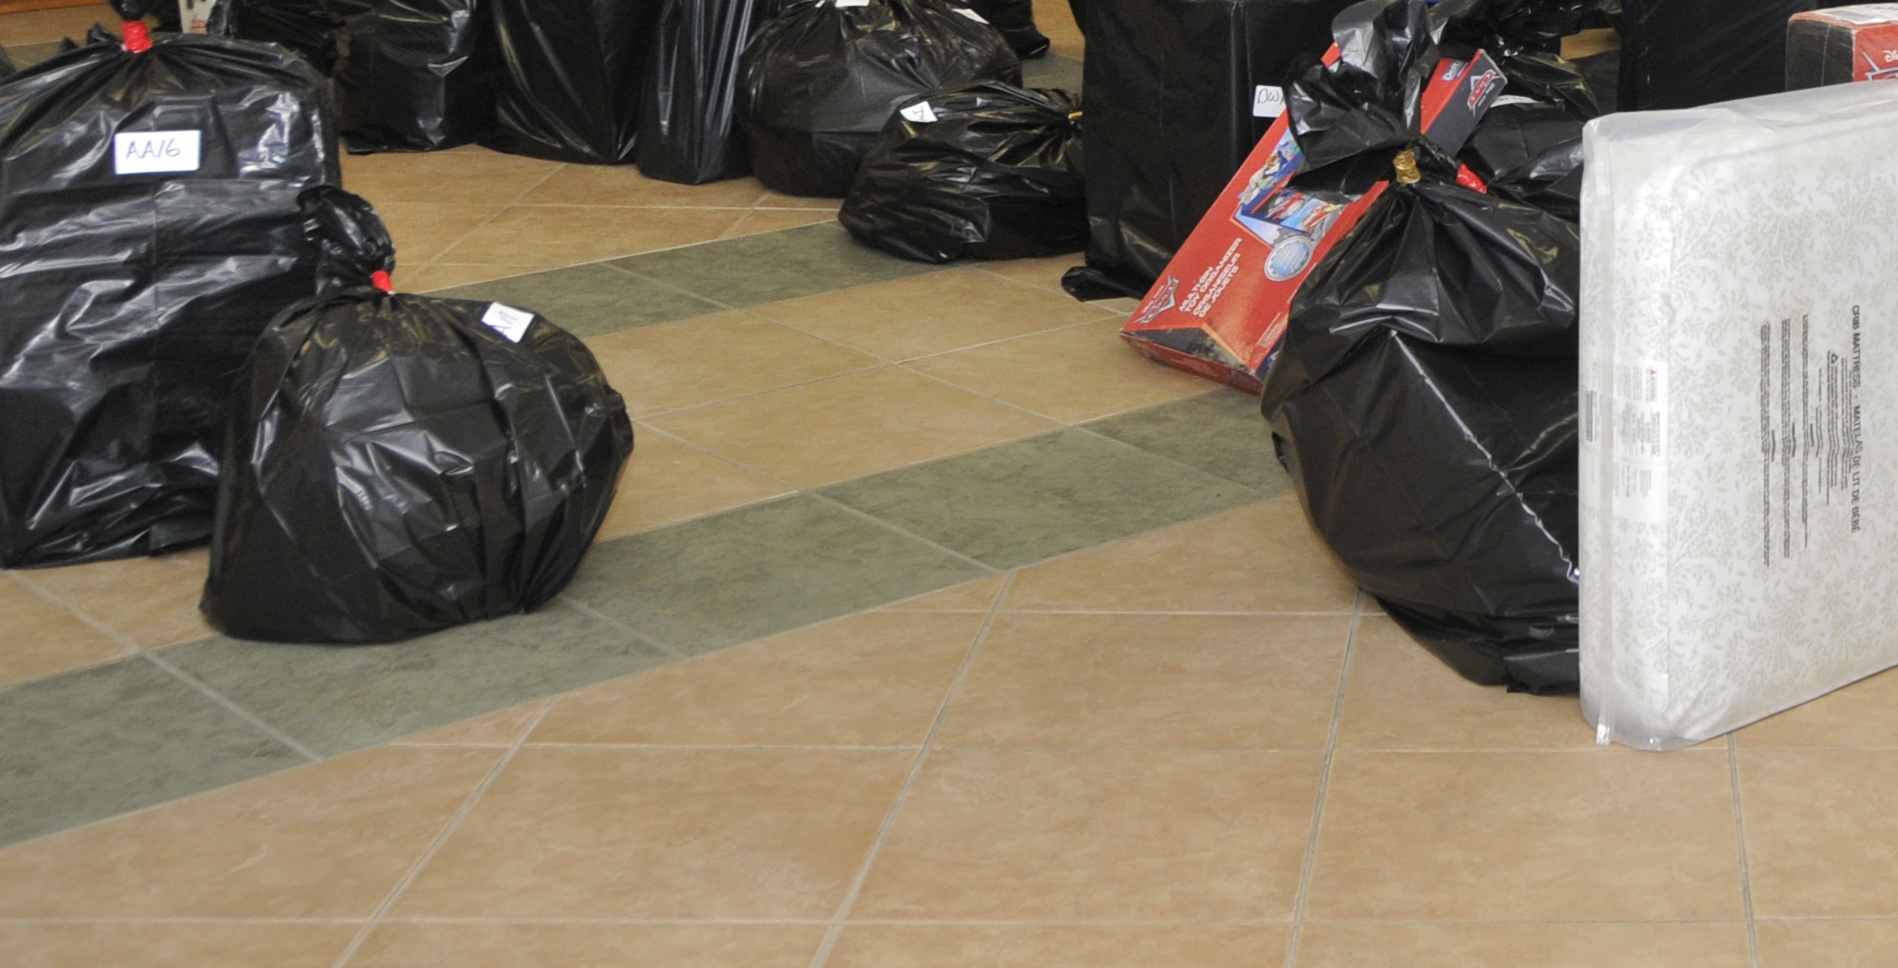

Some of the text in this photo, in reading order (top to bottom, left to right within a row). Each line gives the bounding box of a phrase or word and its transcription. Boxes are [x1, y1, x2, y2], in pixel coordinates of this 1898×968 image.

[126, 138, 182, 159] AA16
[1200, 237, 1243, 293] ORGANIZER
[1193, 253, 1242, 316] ORGANISEUR
[1199, 265, 1240, 318] DE JOUETS
[1851, 304, 1861, 331] CRIB
[1852, 332, 1861, 389] MATTRESS
[1853, 405, 1864, 454] MATELAS
[1851, 471, 1861, 487] LIT
[1852, 455, 1862, 468] DE
[1851, 490, 1861, 504] DE
